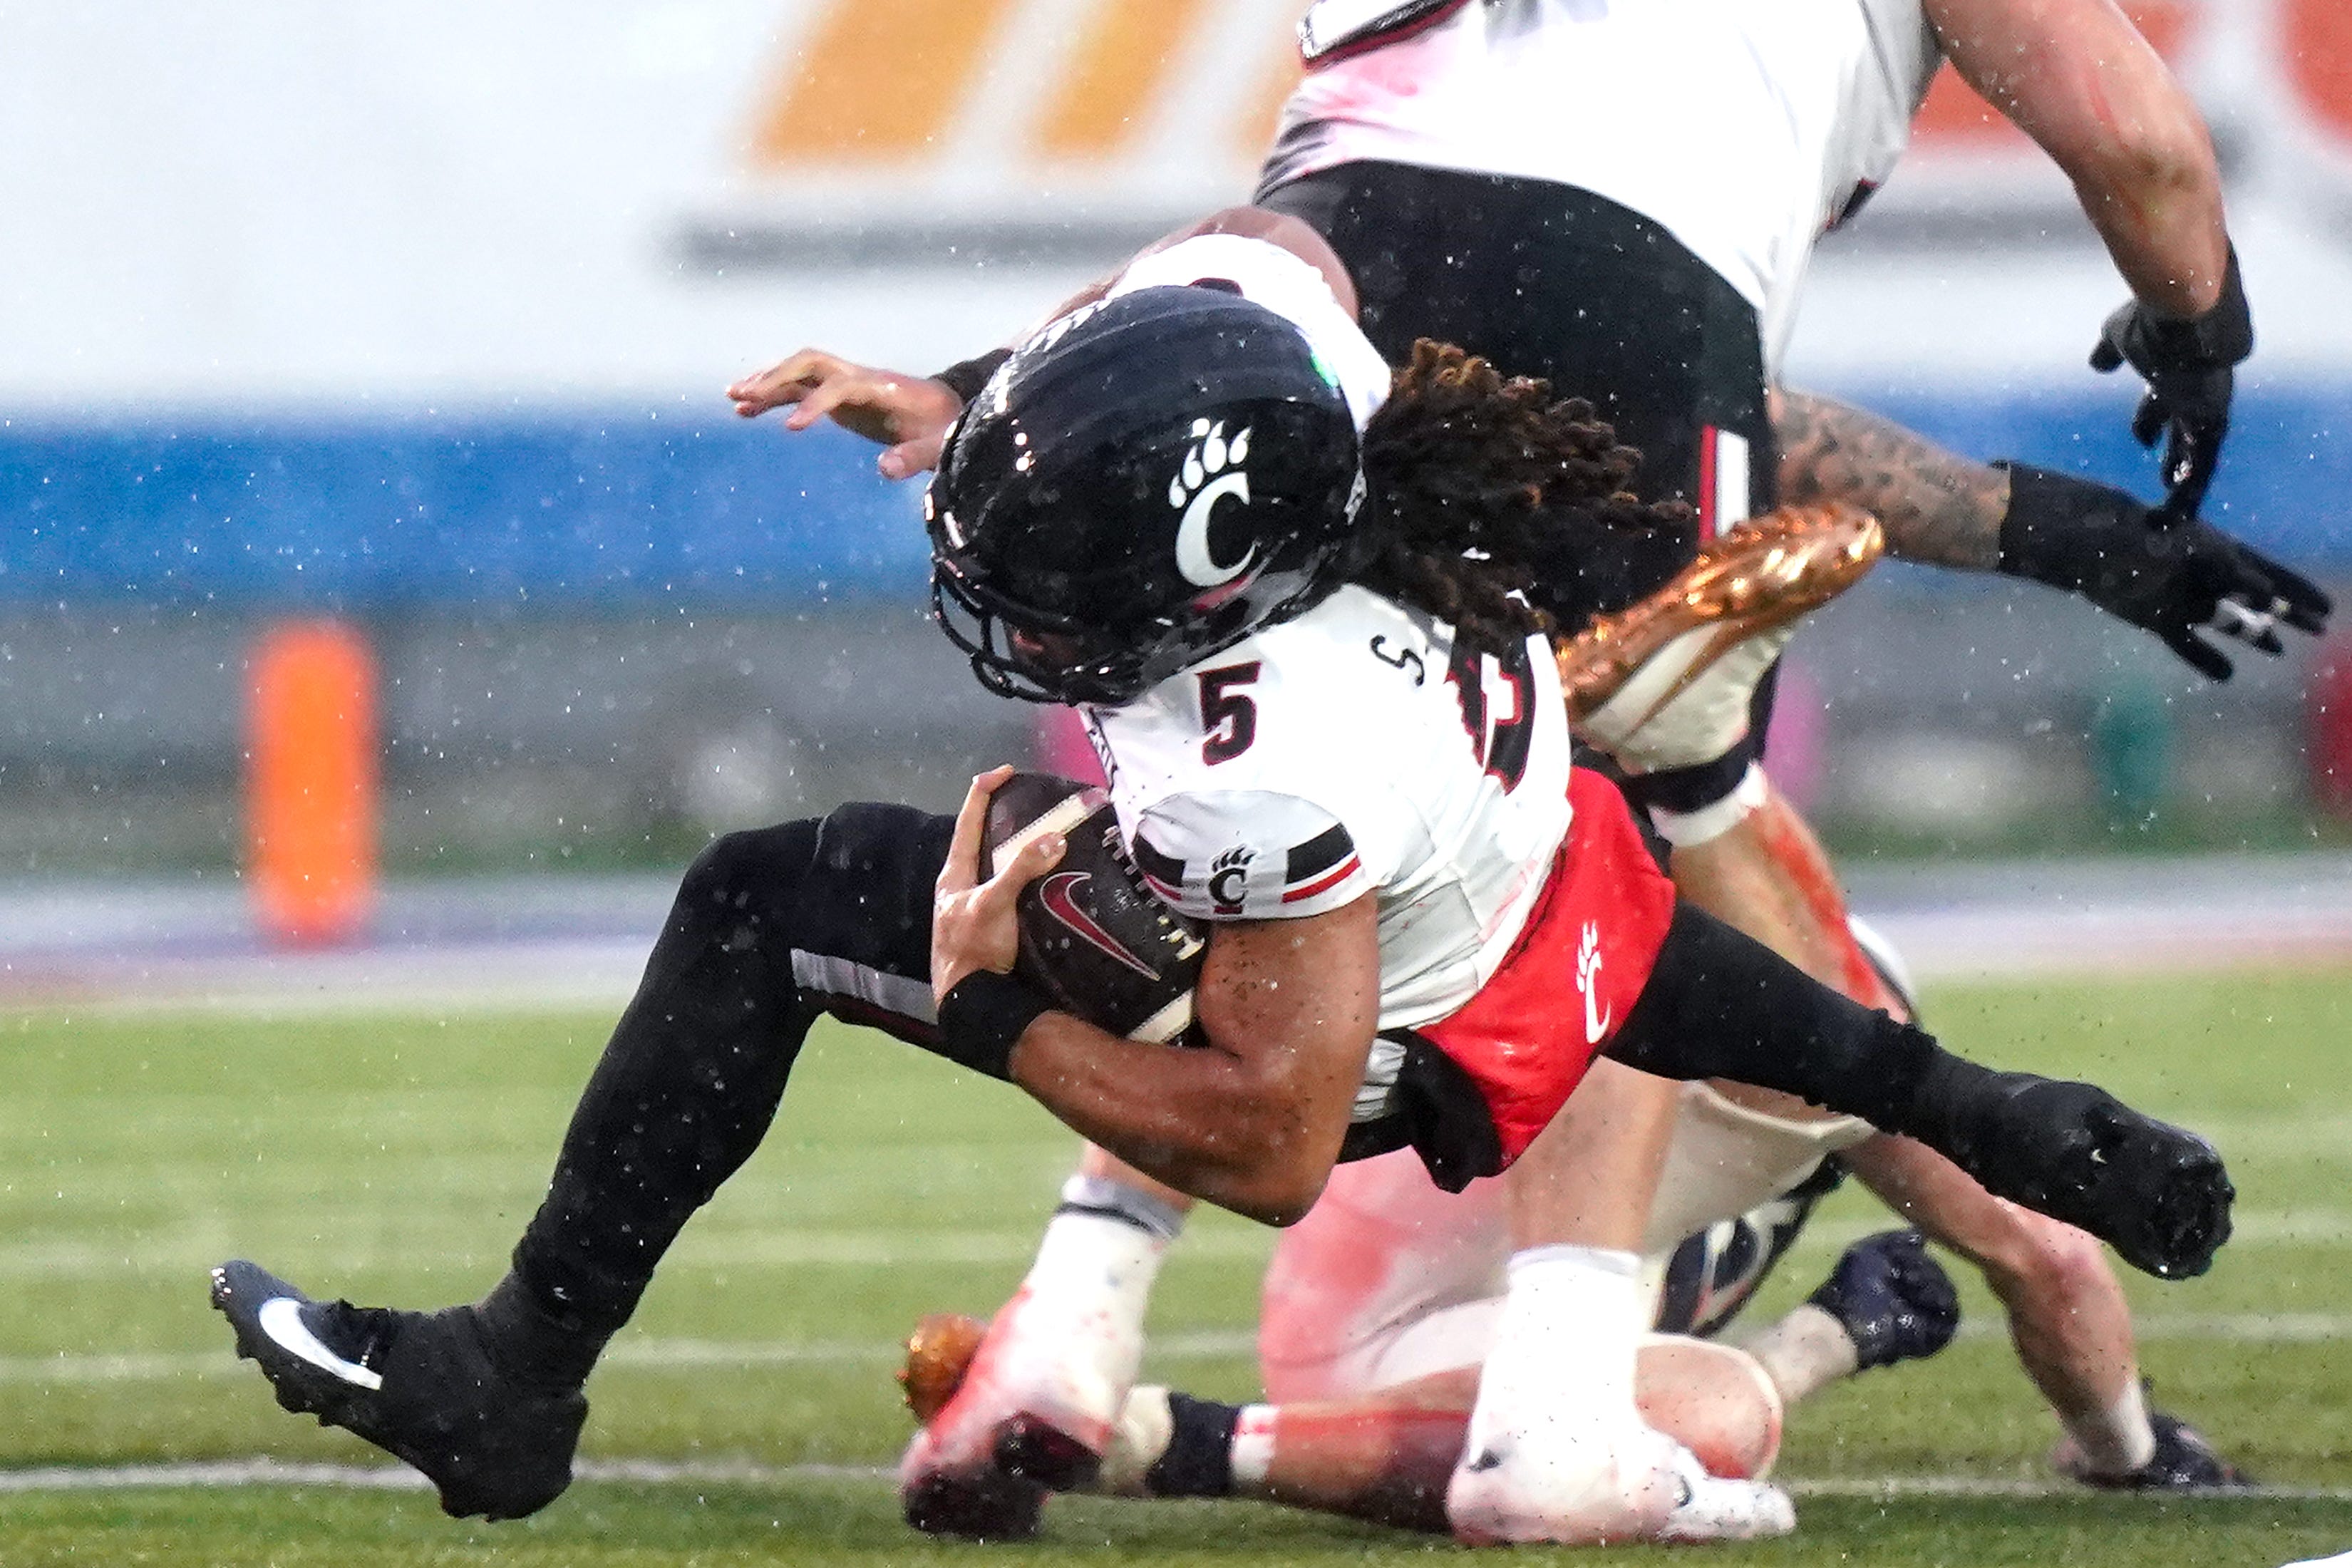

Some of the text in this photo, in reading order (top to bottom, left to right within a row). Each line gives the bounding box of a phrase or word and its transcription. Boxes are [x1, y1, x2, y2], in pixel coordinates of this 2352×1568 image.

[1175, 470, 1262, 587] C
[1195, 660, 1262, 767] 5
[1207, 867, 1249, 906] C
